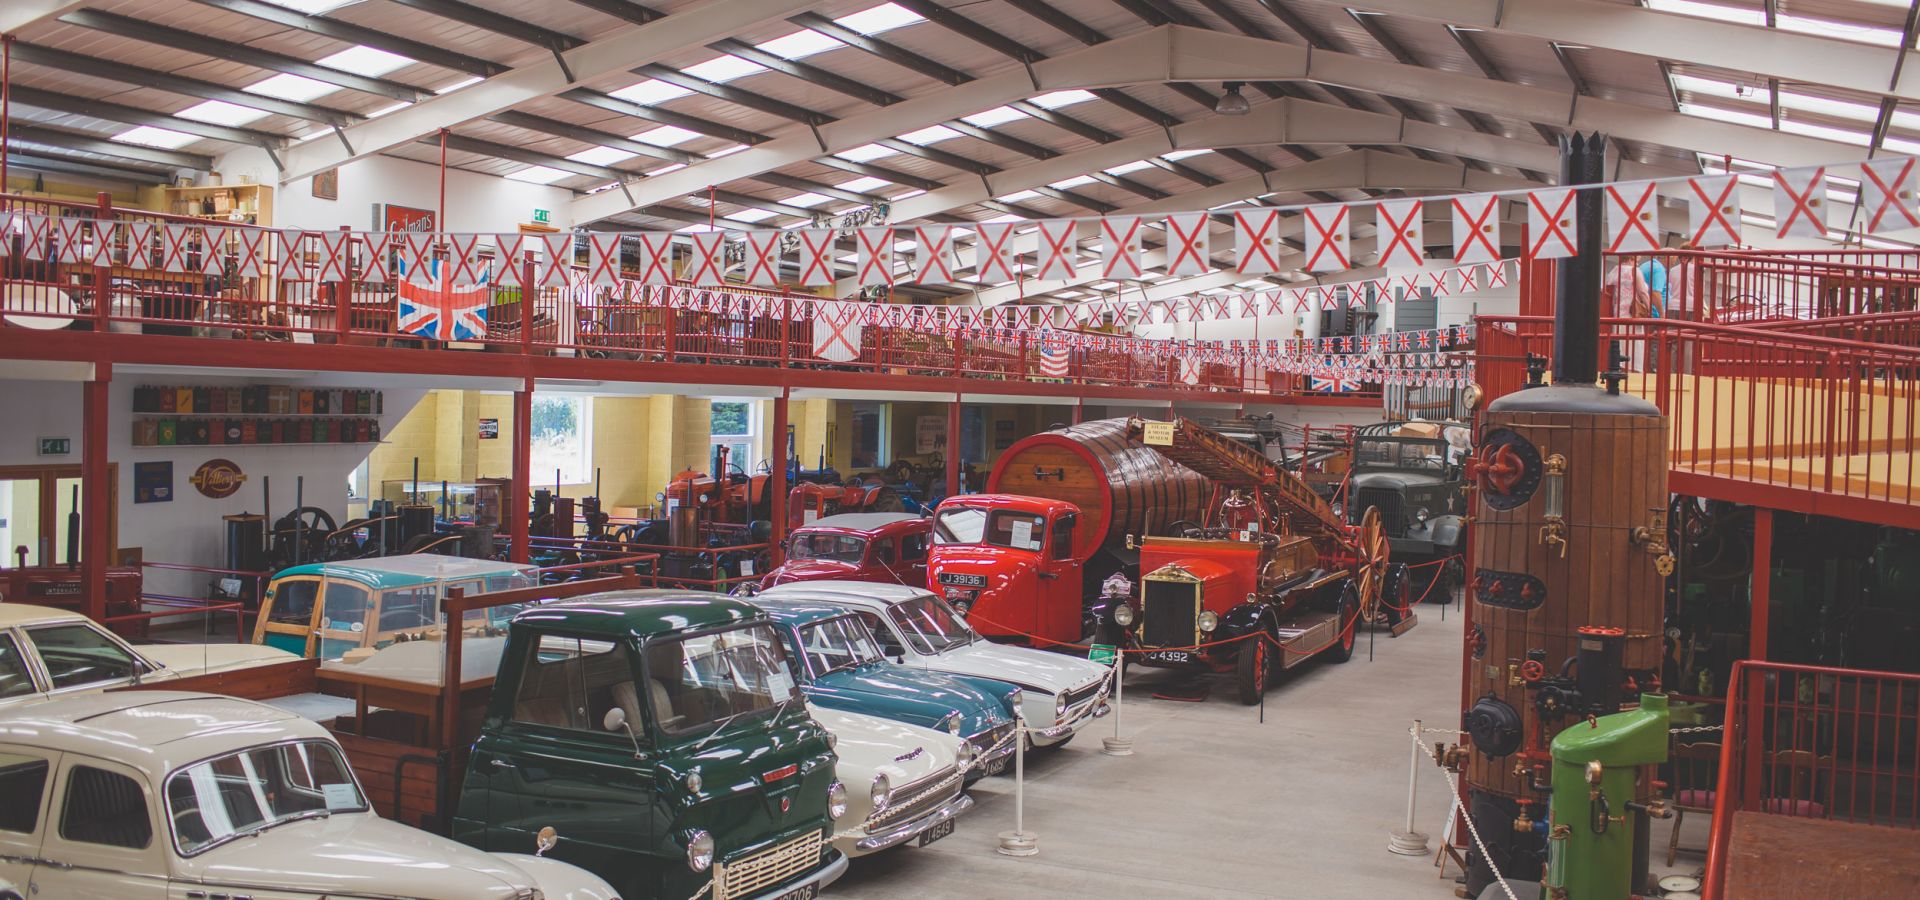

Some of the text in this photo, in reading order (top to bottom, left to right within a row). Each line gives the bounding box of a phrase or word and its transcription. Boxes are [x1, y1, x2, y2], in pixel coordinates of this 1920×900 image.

[945, 575, 980, 585] J 39136
[1159, 650, 1188, 662] 4392
